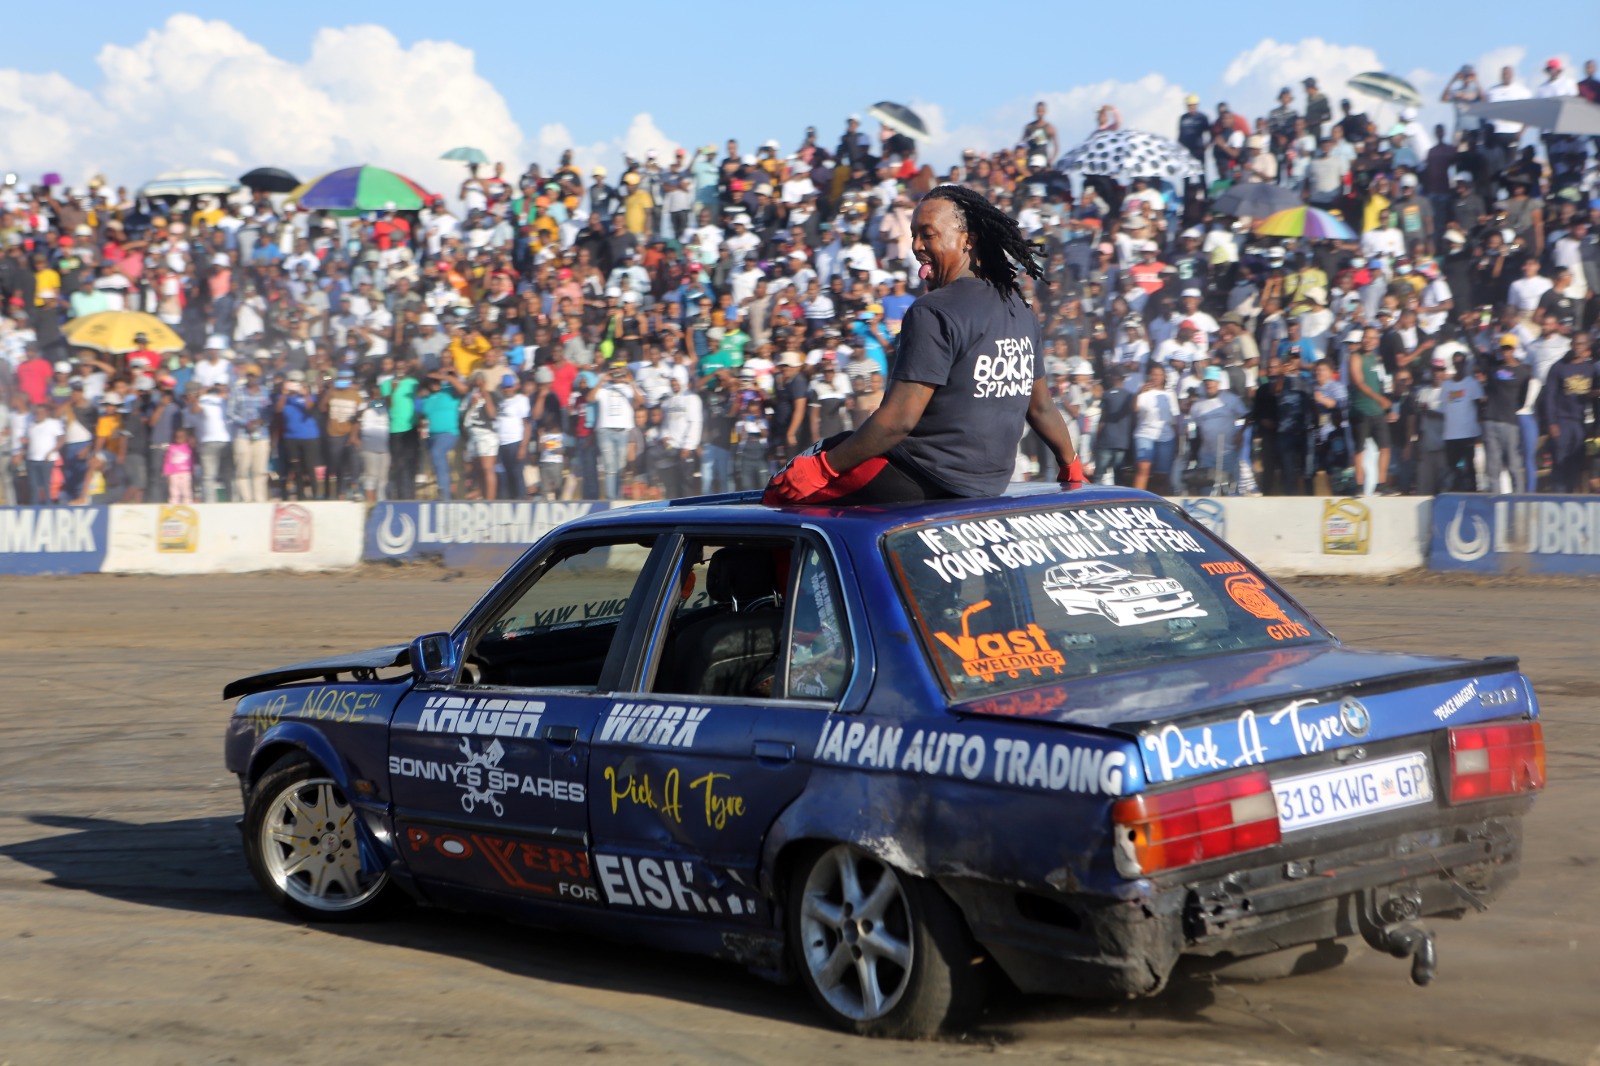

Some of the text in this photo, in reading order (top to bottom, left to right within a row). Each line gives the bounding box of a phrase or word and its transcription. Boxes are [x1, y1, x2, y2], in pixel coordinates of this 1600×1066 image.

[995, 336, 1033, 357] TEAM
[974, 379, 1034, 398] SPINNE
[917, 507, 1172, 555] IF YOUR MIND IS WEAK
[923, 528, 1206, 583] YOUR BODY WILL SUFFER!!
[1200, 561, 1247, 576] TURBO
[933, 600, 1052, 662] Vast
[1266, 622, 1311, 641] GUYS
[971, 652, 1057, 673] WELDING
[416, 696, 547, 739] KRUGER
[1144, 724, 1228, 781] Pick
[1233, 709, 1269, 767] A
[1269, 698, 1344, 755] Tyre
[389, 755, 586, 803] SONNY'S SPARES
[901, 729, 986, 780] AUTO
[994, 738, 1127, 797] TRADING
[604, 766, 746, 830] Pick A Tyre
[1277, 763, 1425, 822] 318 KWG GP
